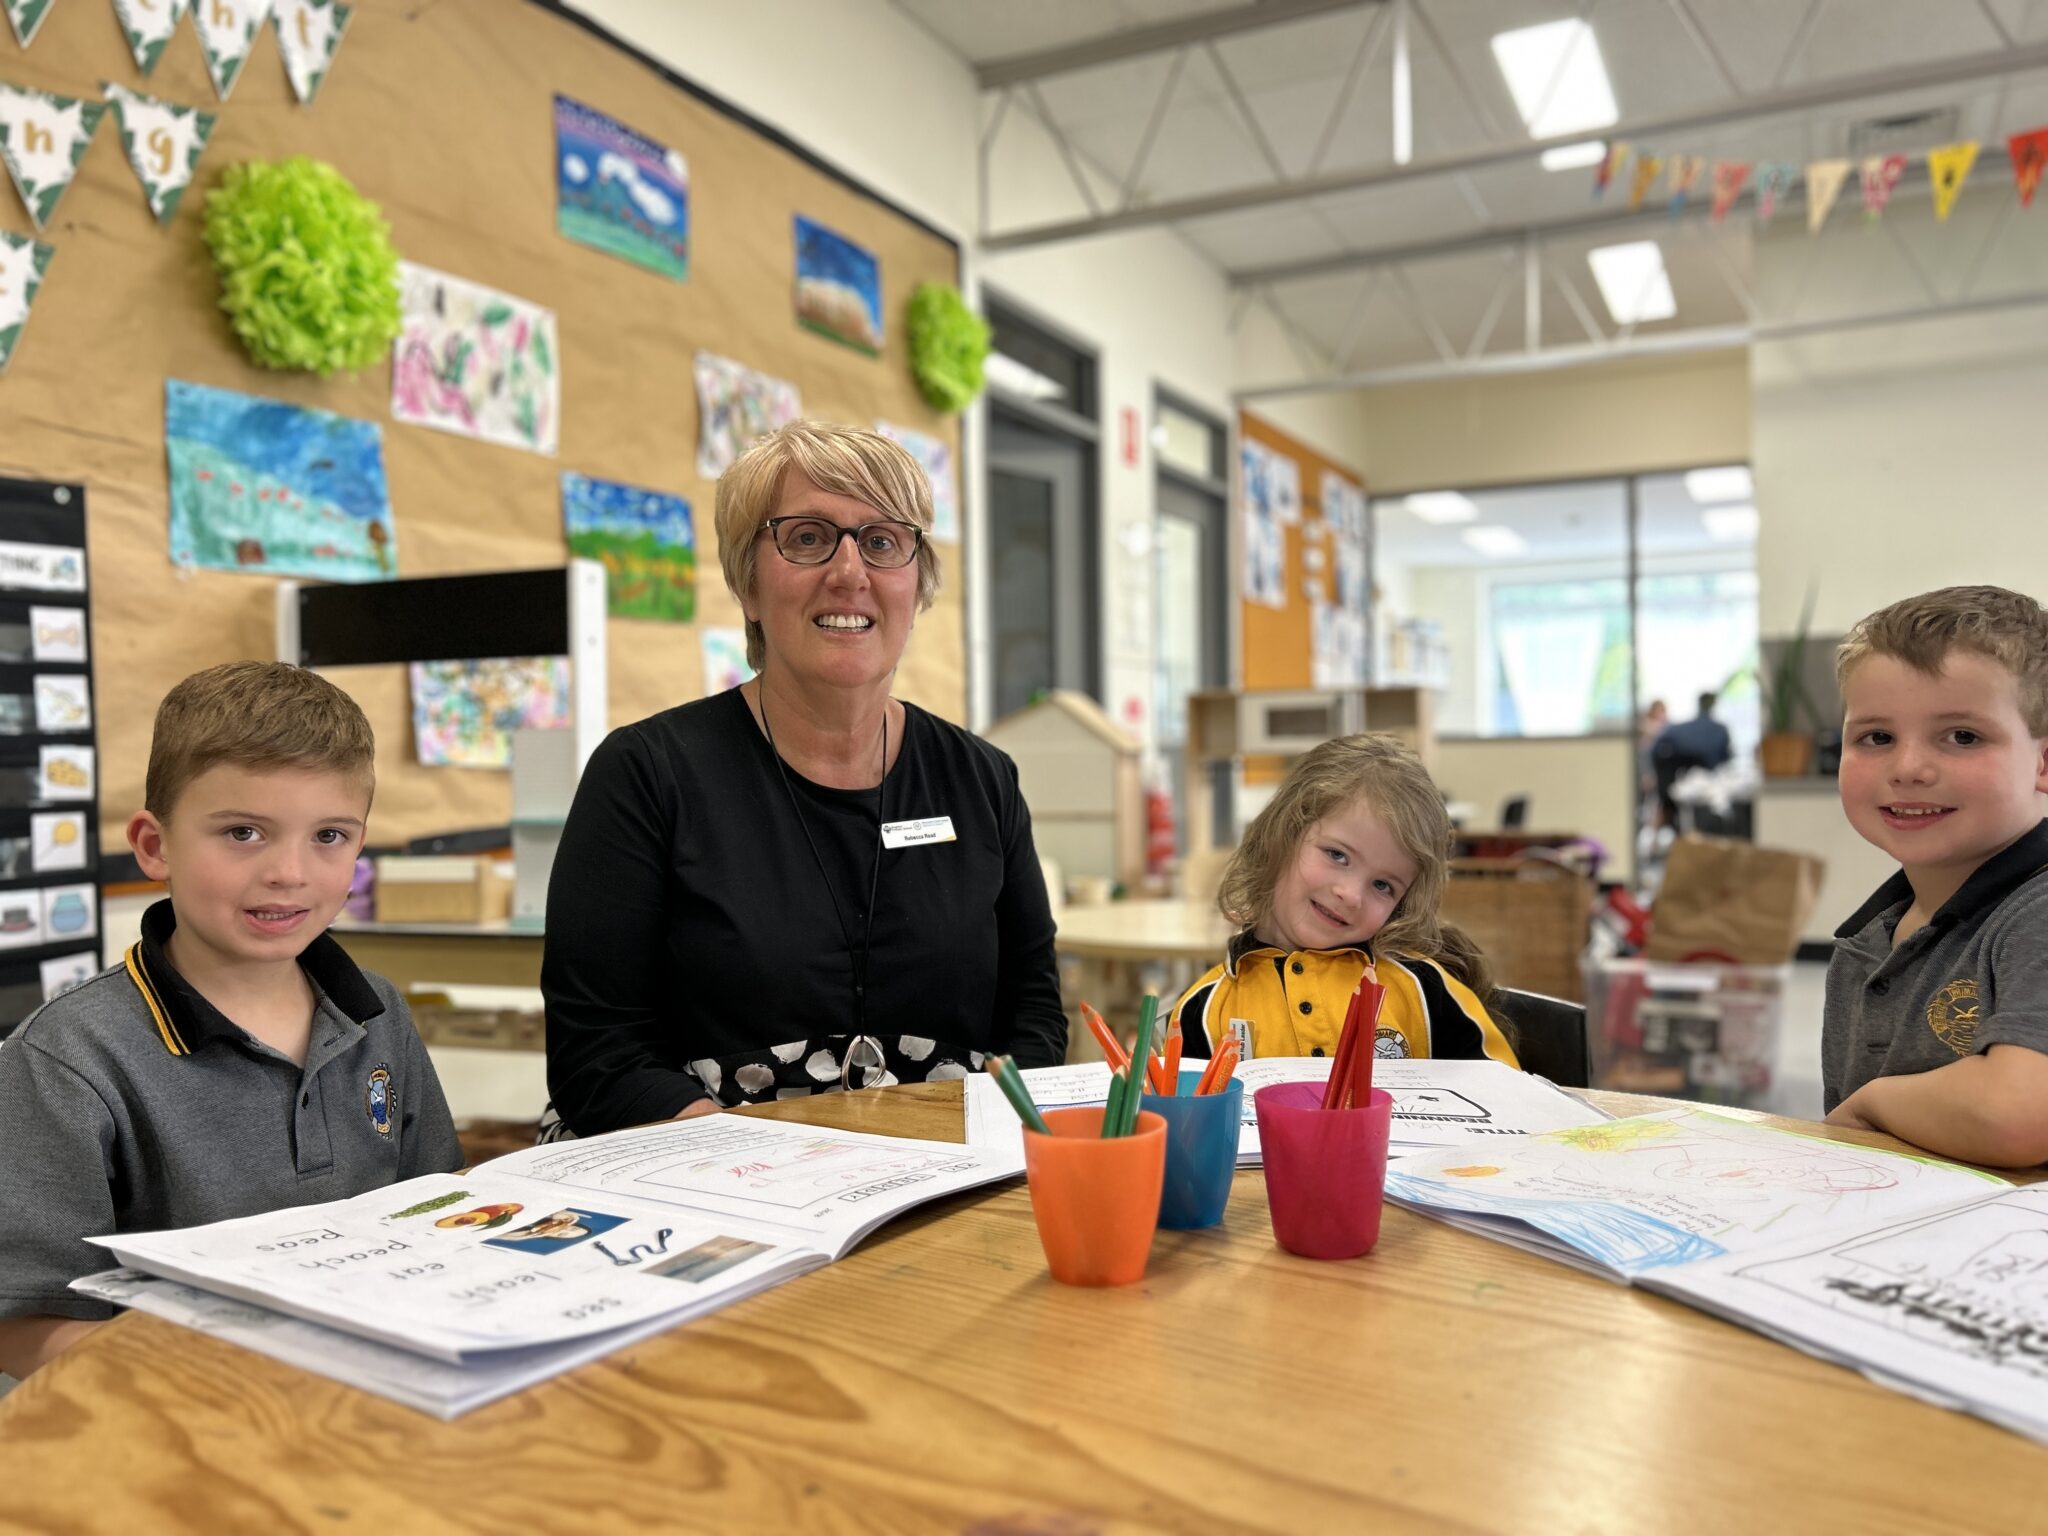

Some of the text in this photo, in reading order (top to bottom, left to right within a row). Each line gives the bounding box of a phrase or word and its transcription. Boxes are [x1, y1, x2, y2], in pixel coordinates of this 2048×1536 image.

[1390, 1115, 1493, 1125] BEGINNIN
[1463, 1127, 1530, 1136] TITLE:
[255, 1229, 345, 1252] peas
[297, 1239, 413, 1271] peach
[388, 1262, 445, 1281] eat
[448, 1271, 562, 1303] leash
[562, 1298, 622, 1321] sea
